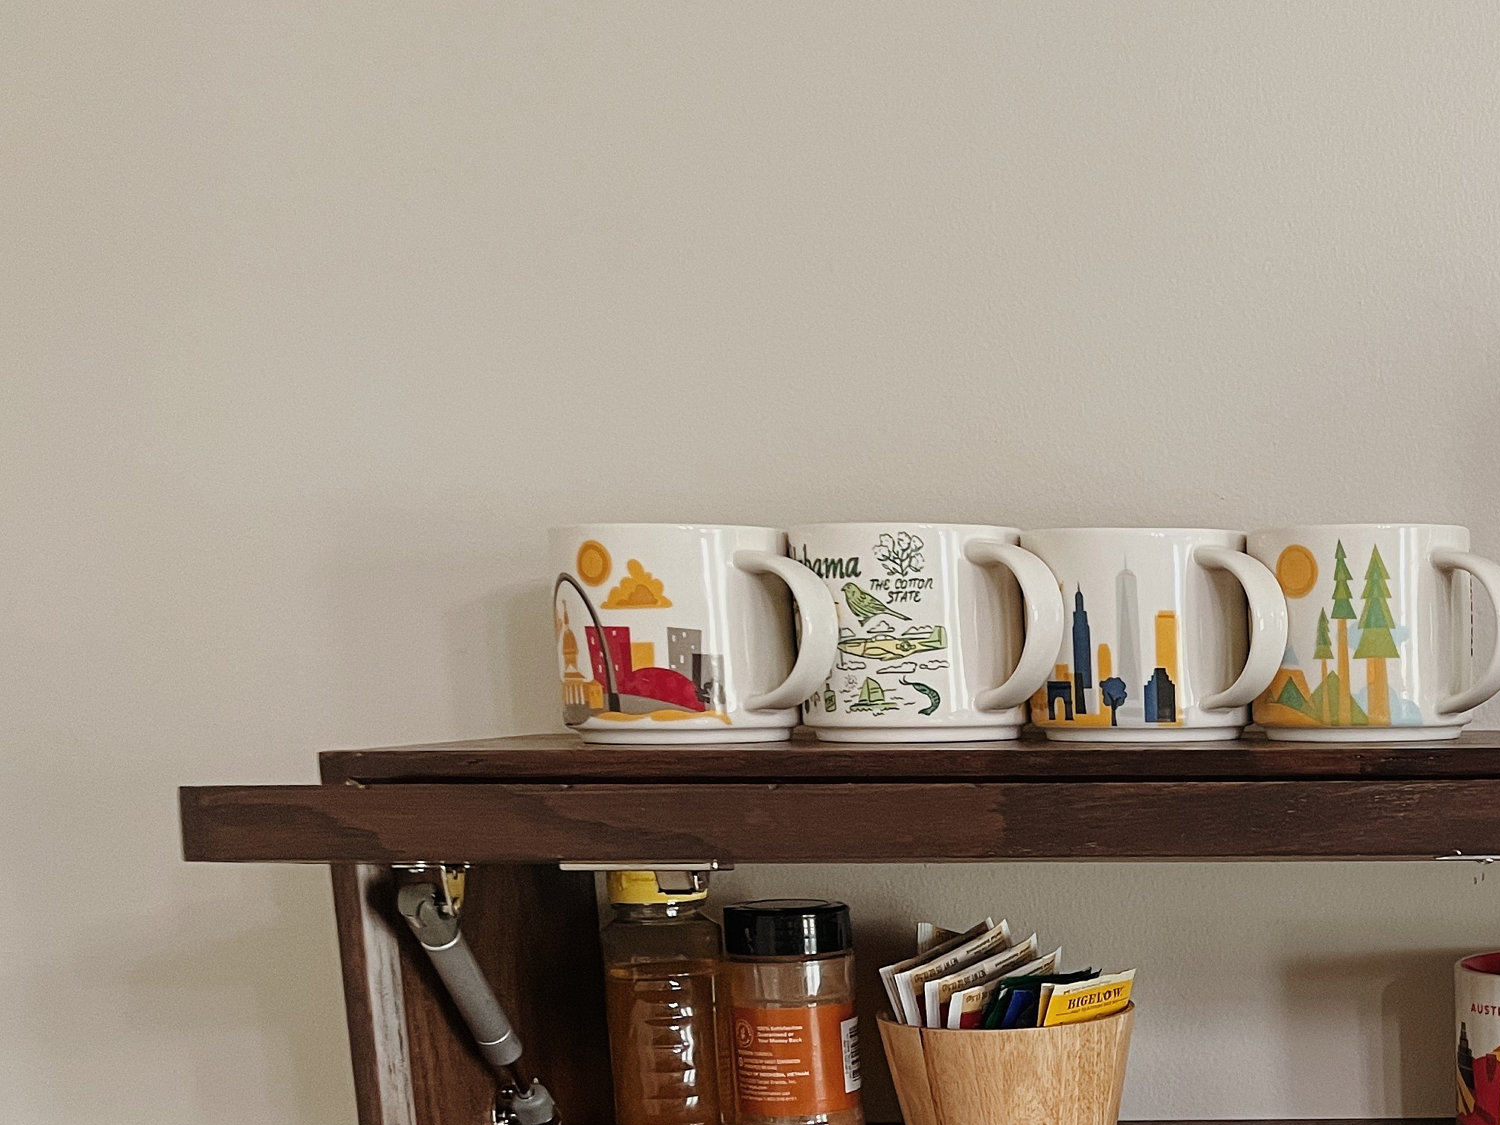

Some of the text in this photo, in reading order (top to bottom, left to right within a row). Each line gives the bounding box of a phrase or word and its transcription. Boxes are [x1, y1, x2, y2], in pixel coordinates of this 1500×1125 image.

[793, 543, 862, 579] bama
[870, 577, 934, 591] THE COTTON
[886, 590, 922, 605] STATE
[1067, 985, 1126, 1010] BIGELOW
